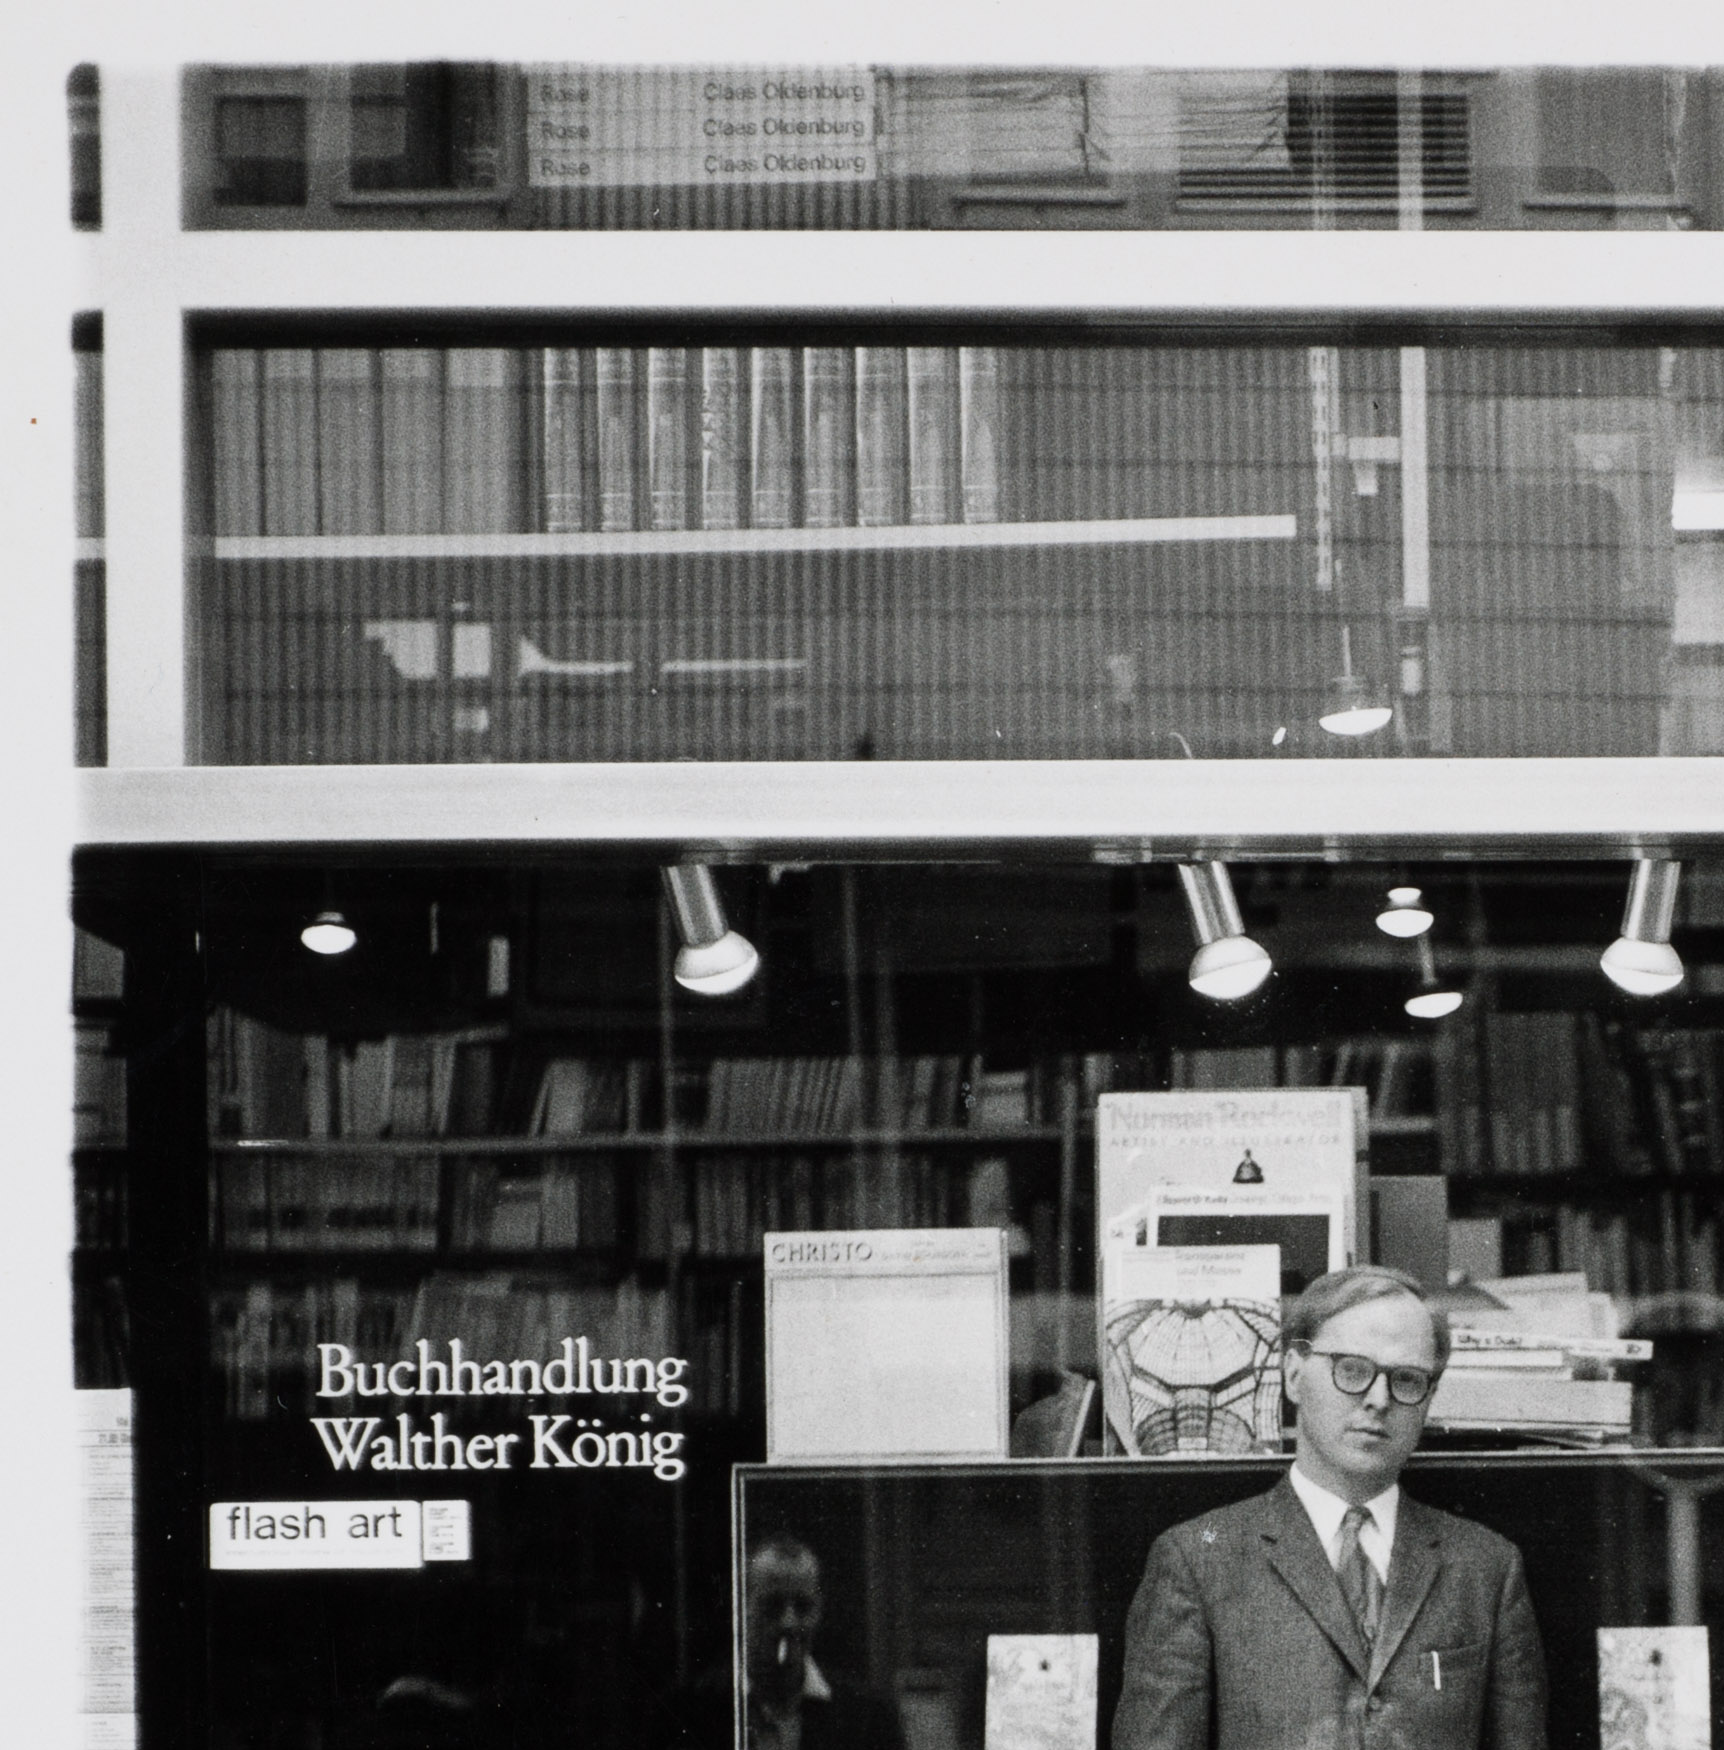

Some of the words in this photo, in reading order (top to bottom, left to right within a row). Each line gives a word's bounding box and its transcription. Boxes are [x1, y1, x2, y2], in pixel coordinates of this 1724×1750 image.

[762, 117, 865, 138] Oldenburg
[763, 154, 866, 175] Oldenburg
[772, 1242, 873, 1263] CHRISTO
[315, 1336, 689, 1407] Buchhandlung
[310, 1412, 520, 1471] Walther
[528, 1413, 685, 1481] König
[228, 1506, 326, 1540] flash
[349, 1506, 402, 1538] art
